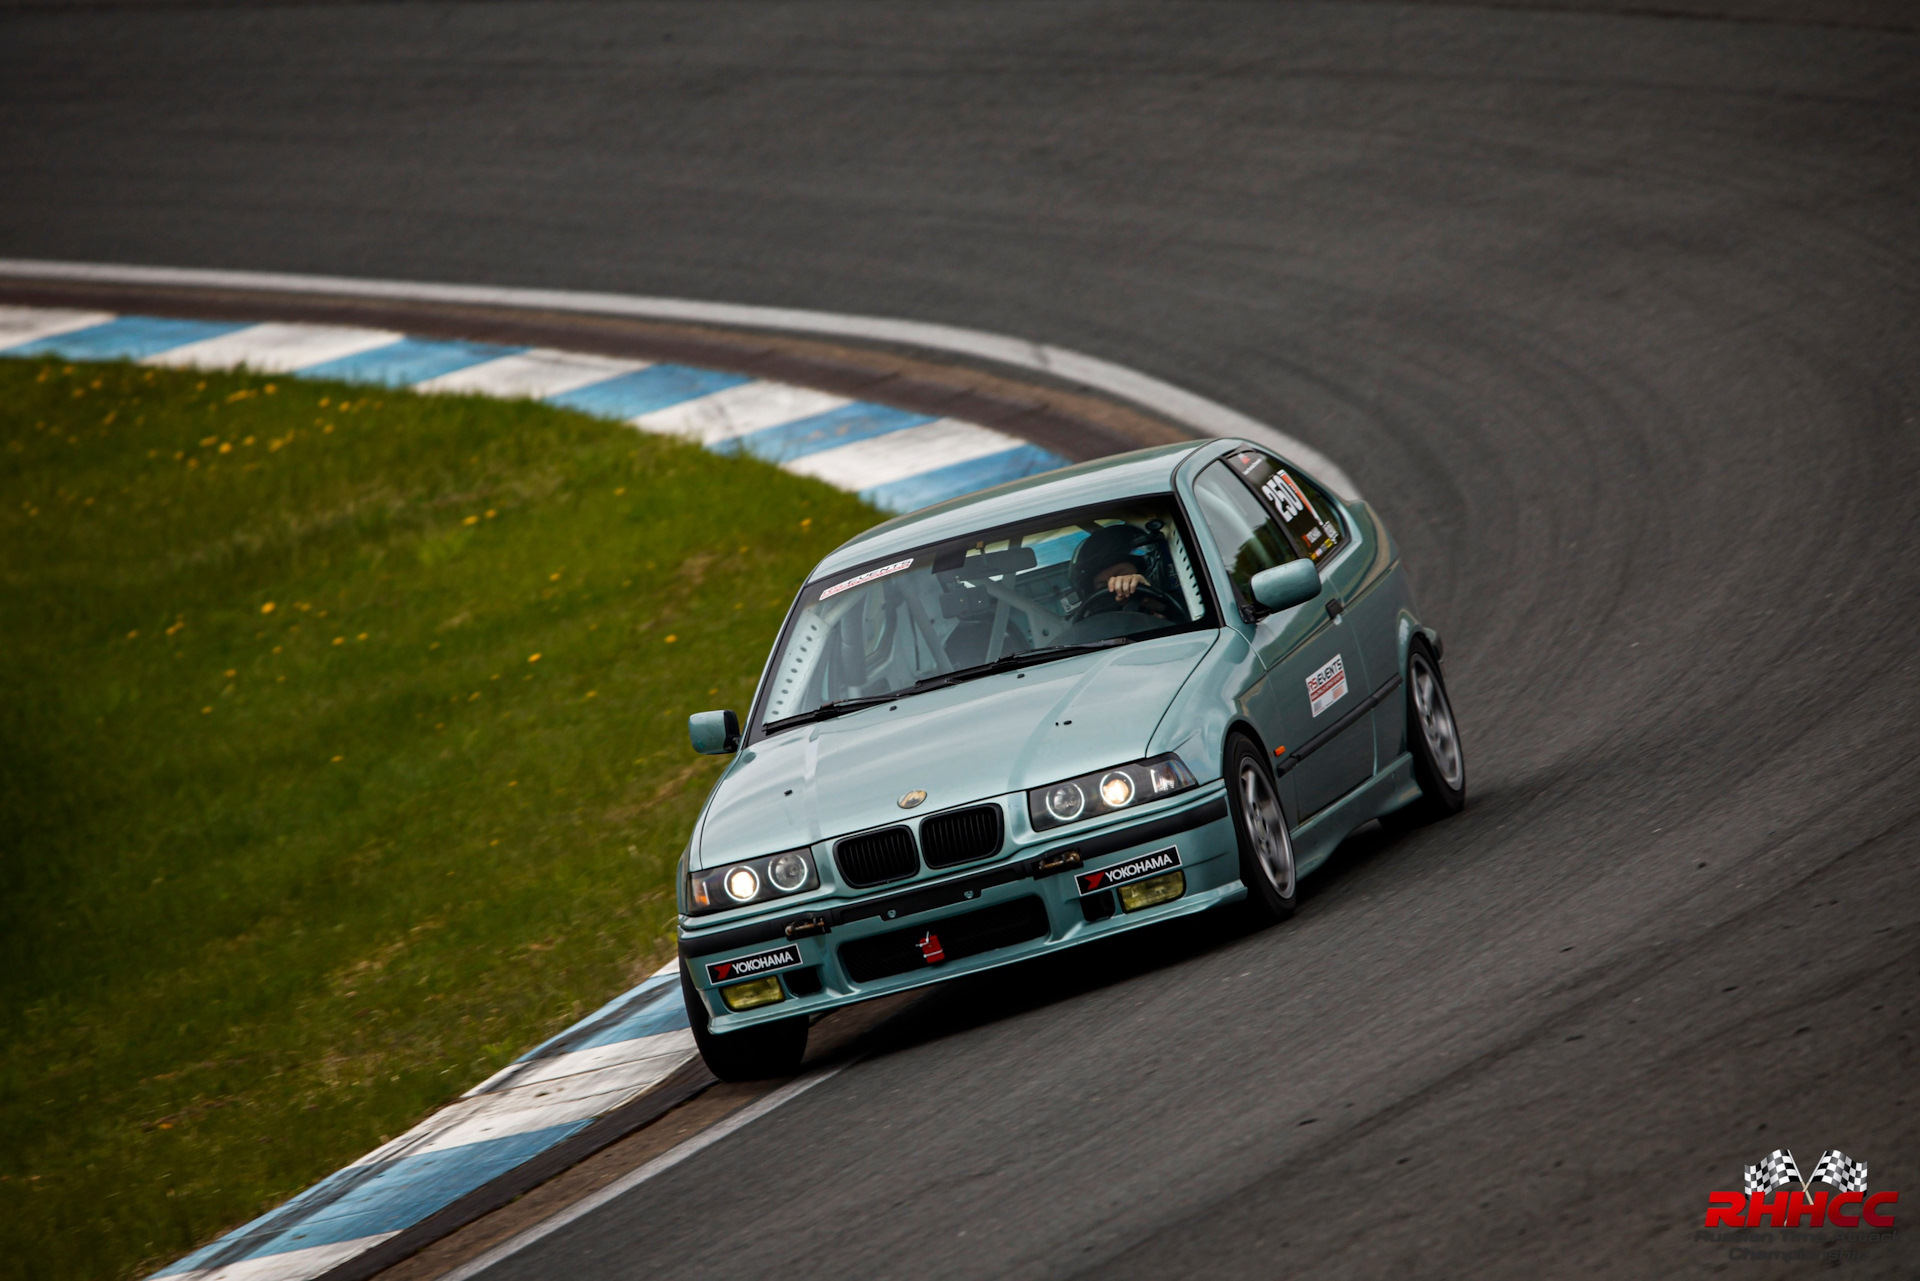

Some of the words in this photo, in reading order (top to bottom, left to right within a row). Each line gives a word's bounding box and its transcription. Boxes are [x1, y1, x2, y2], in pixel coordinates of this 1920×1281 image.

[1262, 474, 1304, 522] 250
[1105, 853, 1173, 882] YOKOHAMA
[732, 950, 794, 974] YOKOHAMA
